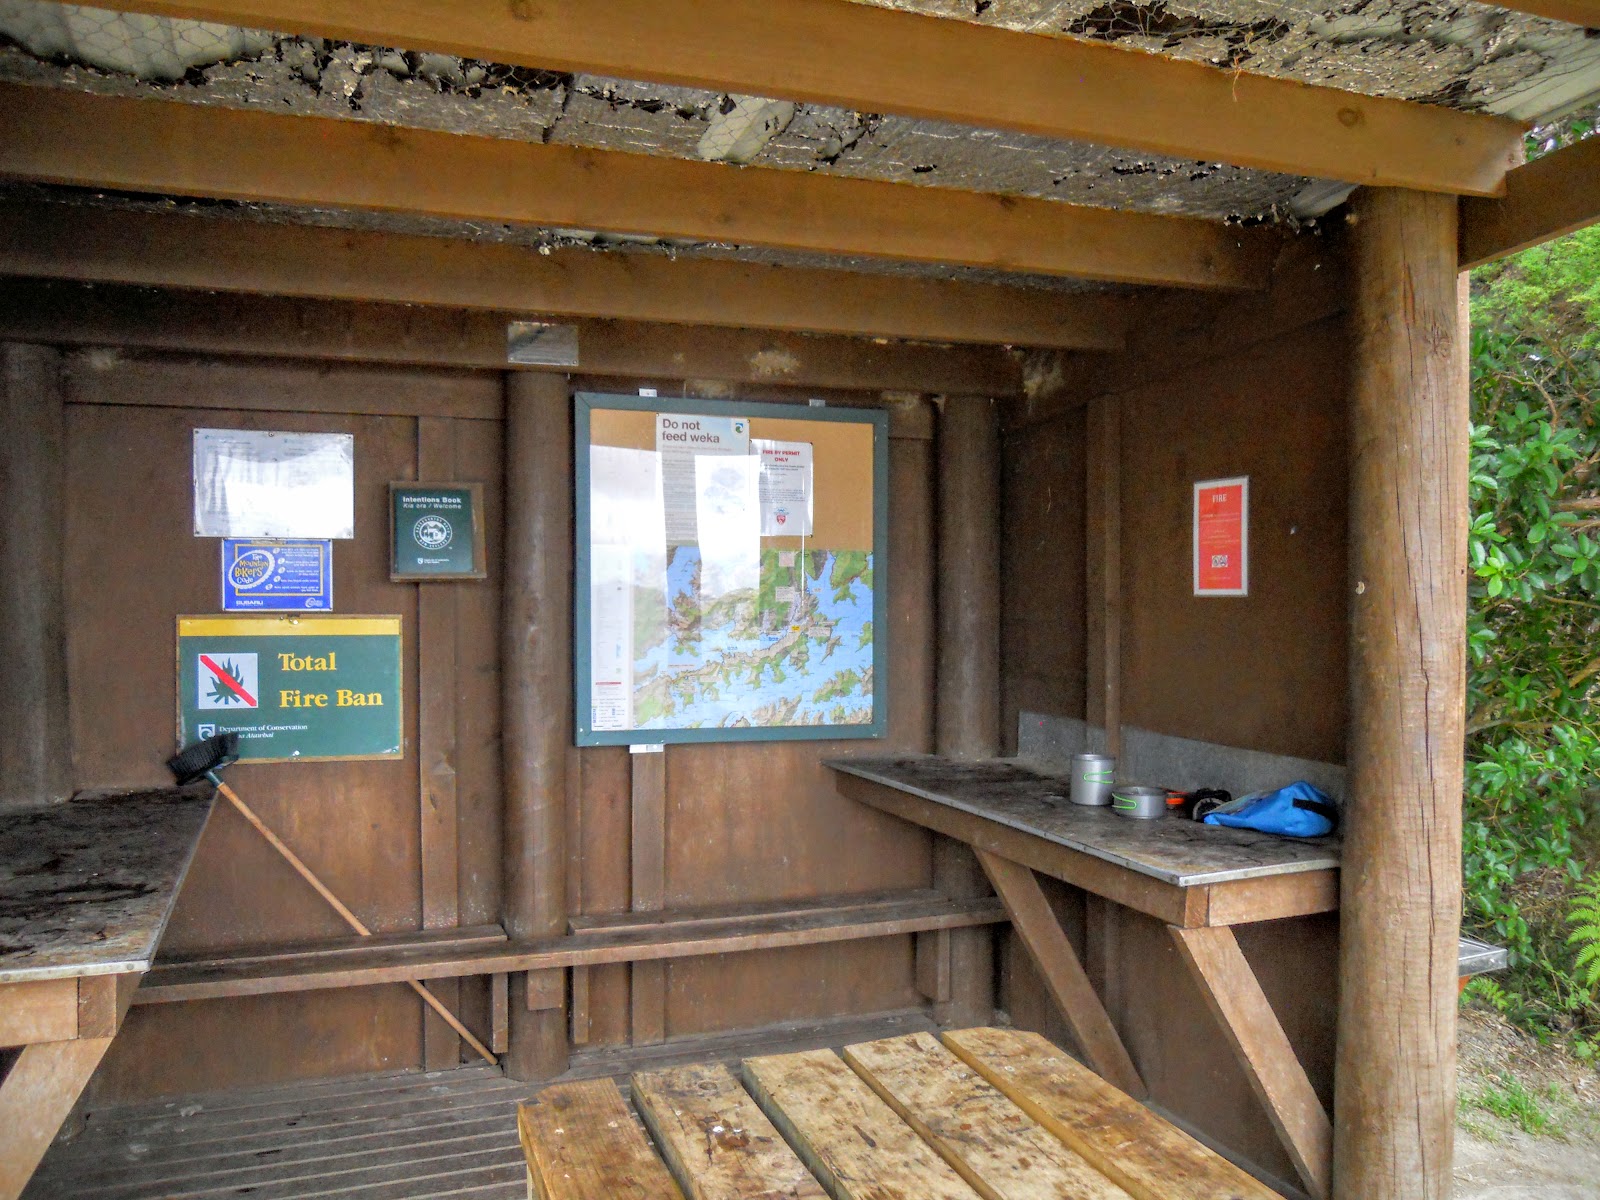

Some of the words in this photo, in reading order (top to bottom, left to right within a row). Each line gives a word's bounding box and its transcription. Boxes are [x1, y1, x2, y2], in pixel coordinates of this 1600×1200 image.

[662, 418, 679, 429] Do
[681, 420, 701, 431] not
[662, 430, 687, 442] feed
[690, 432, 720, 443] weka
[1212, 494, 1227, 503] FIRE
[278, 651, 337, 671] Total
[279, 689, 329, 708] Fire
[335, 689, 384, 707] Ban
[219, 724, 257, 733] Department
[258, 723, 266, 731] of
[266, 723, 308, 731] Conservation
